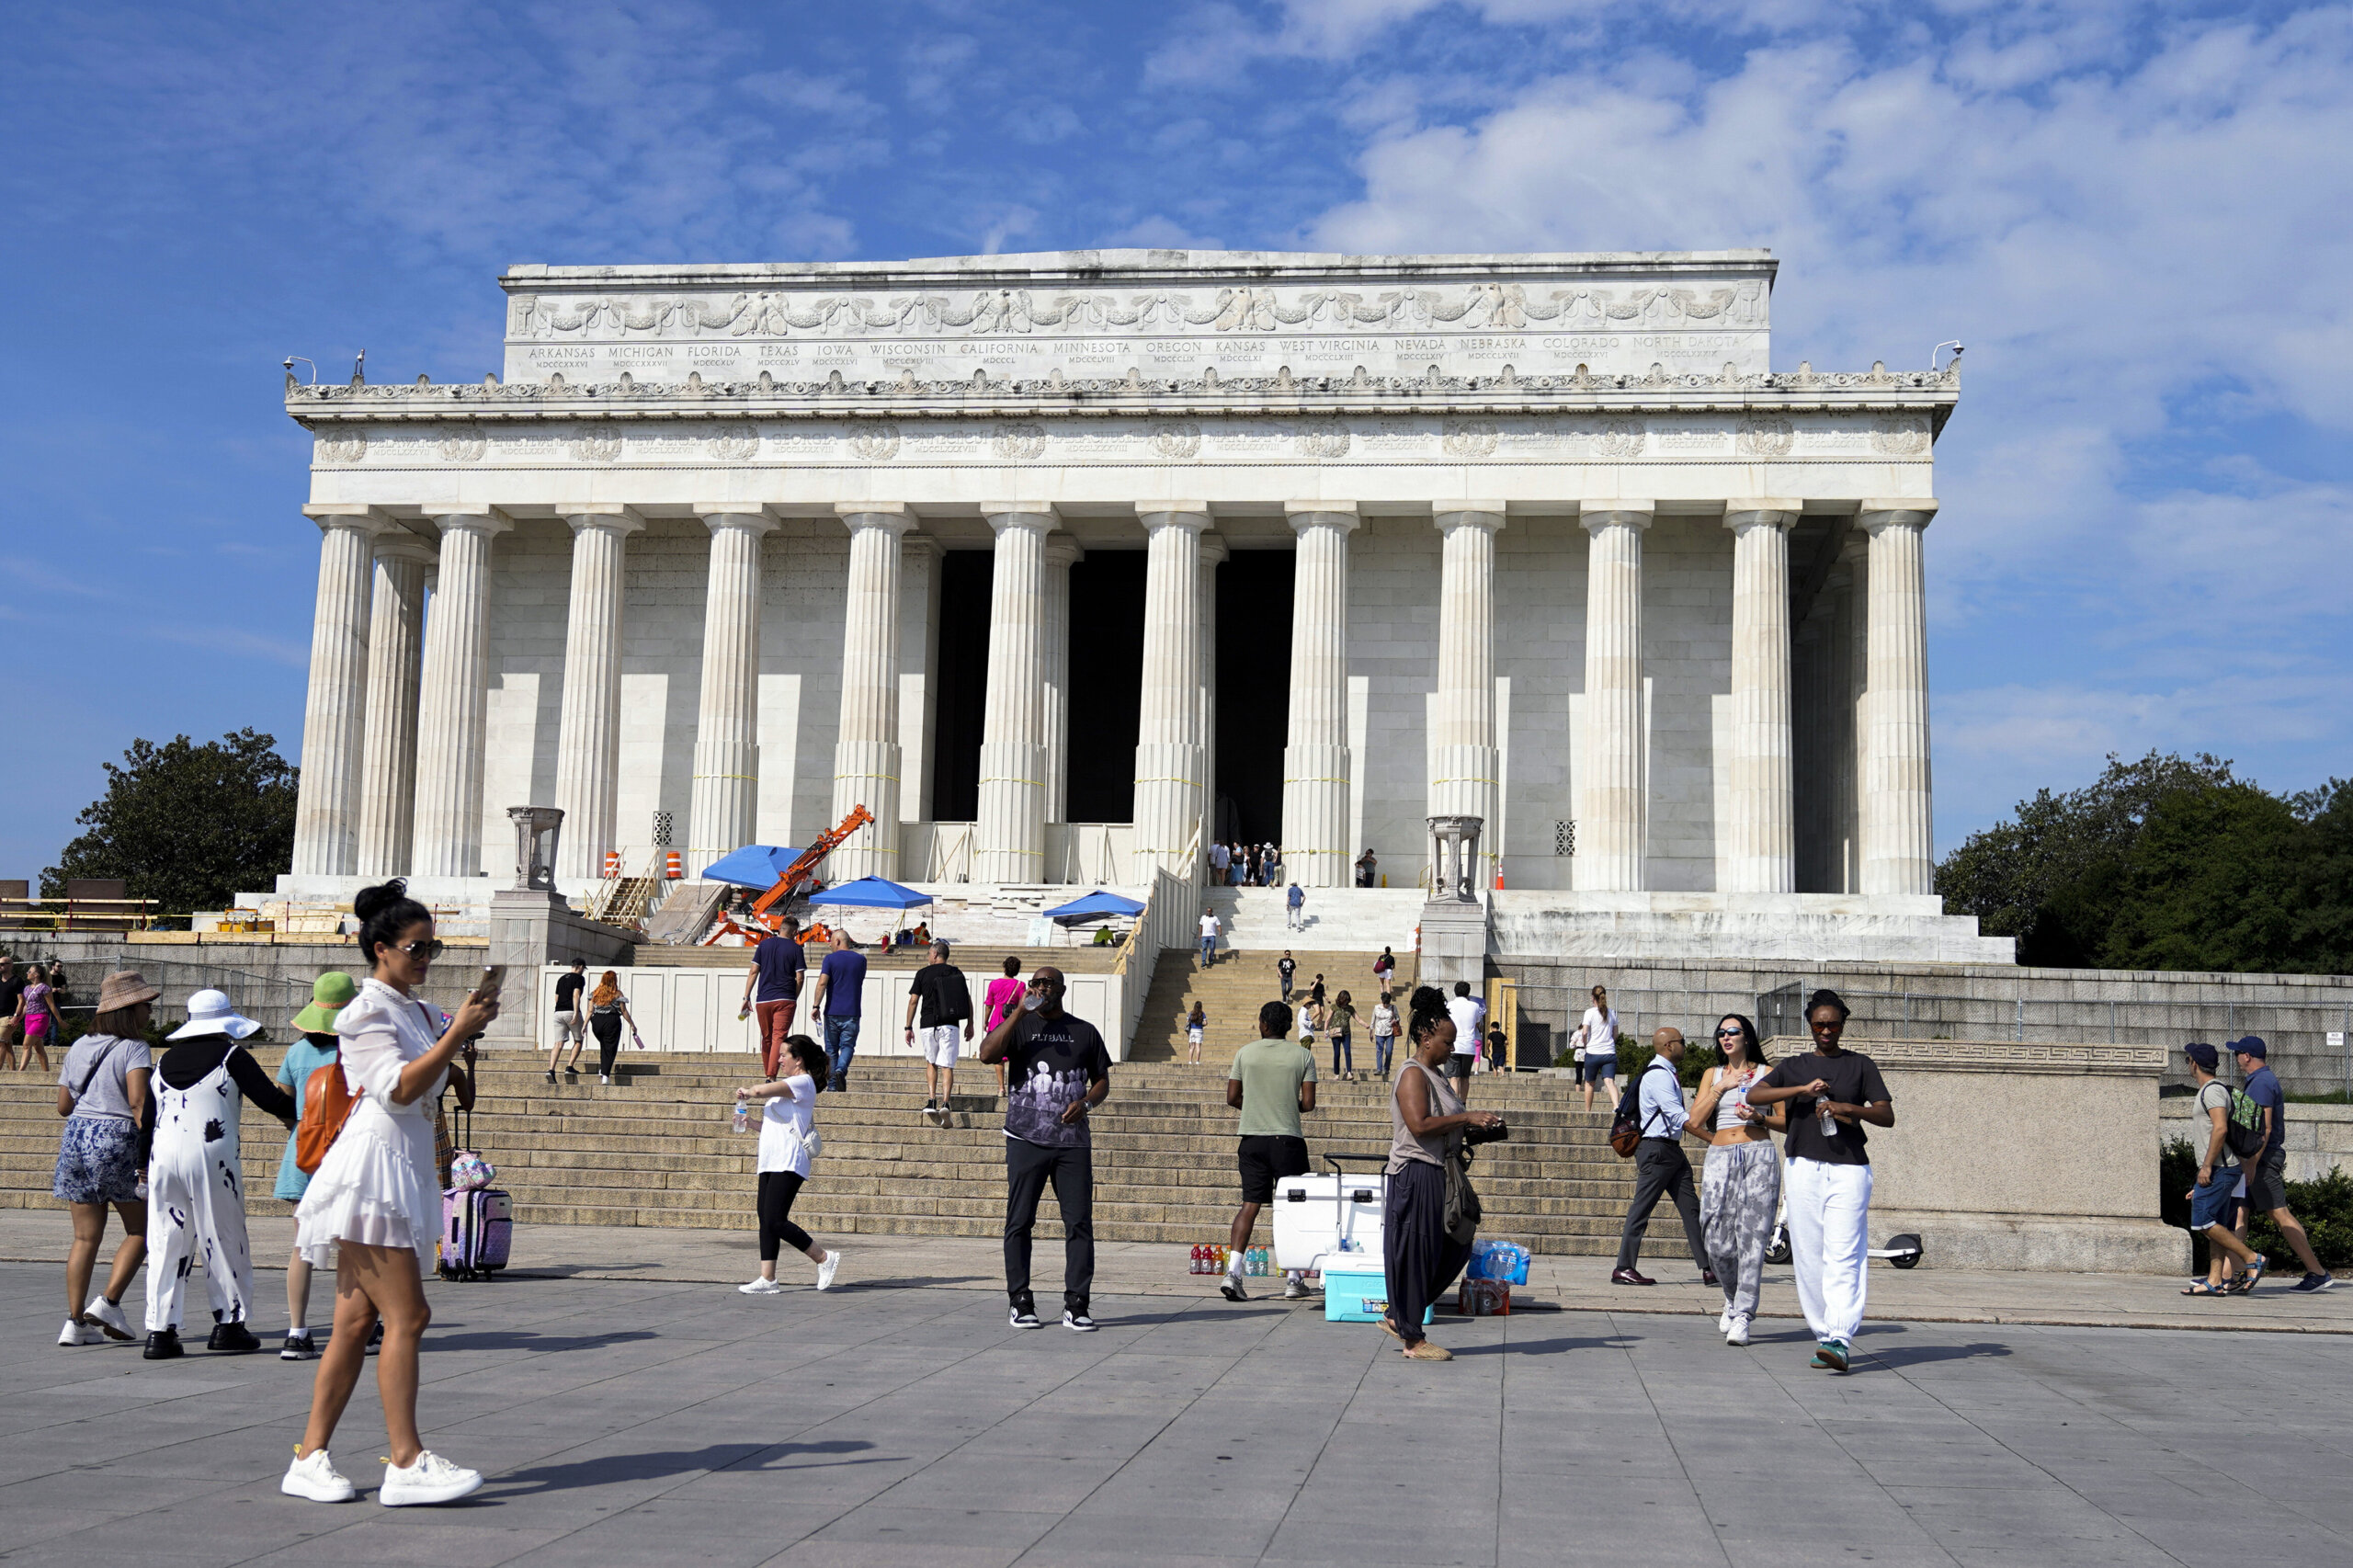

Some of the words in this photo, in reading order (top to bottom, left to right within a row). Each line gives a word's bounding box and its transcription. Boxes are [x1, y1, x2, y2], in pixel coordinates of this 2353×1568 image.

[1216, 341, 1266, 352] KANSAS
[1279, 340, 1314, 351] WEST
[1319, 340, 1380, 351] VIRGINIA
[1395, 339, 1446, 350] NEVADA
[1461, 338, 1527, 349] NEBRASKA
[1543, 337, 1620, 348] COLORADO
[1633, 337, 1681, 347] NORTH
[1688, 336, 1739, 347] DAKOTA
[529, 347, 596, 358] ARKANSAS
[608, 347, 674, 358] MICHIGAN
[688, 346, 742, 357] FLORIDA
[759, 346, 798, 356] TEXAS
[817, 346, 853, 356] IOWA
[870, 344, 946, 355] WISCONSIN
[961, 344, 1038, 355] CALIFORNIA
[1053, 342, 1131, 354] MINNESOTA
[1146, 342, 1202, 353] OREGON
[772, 434, 838, 446] GEORGIA
